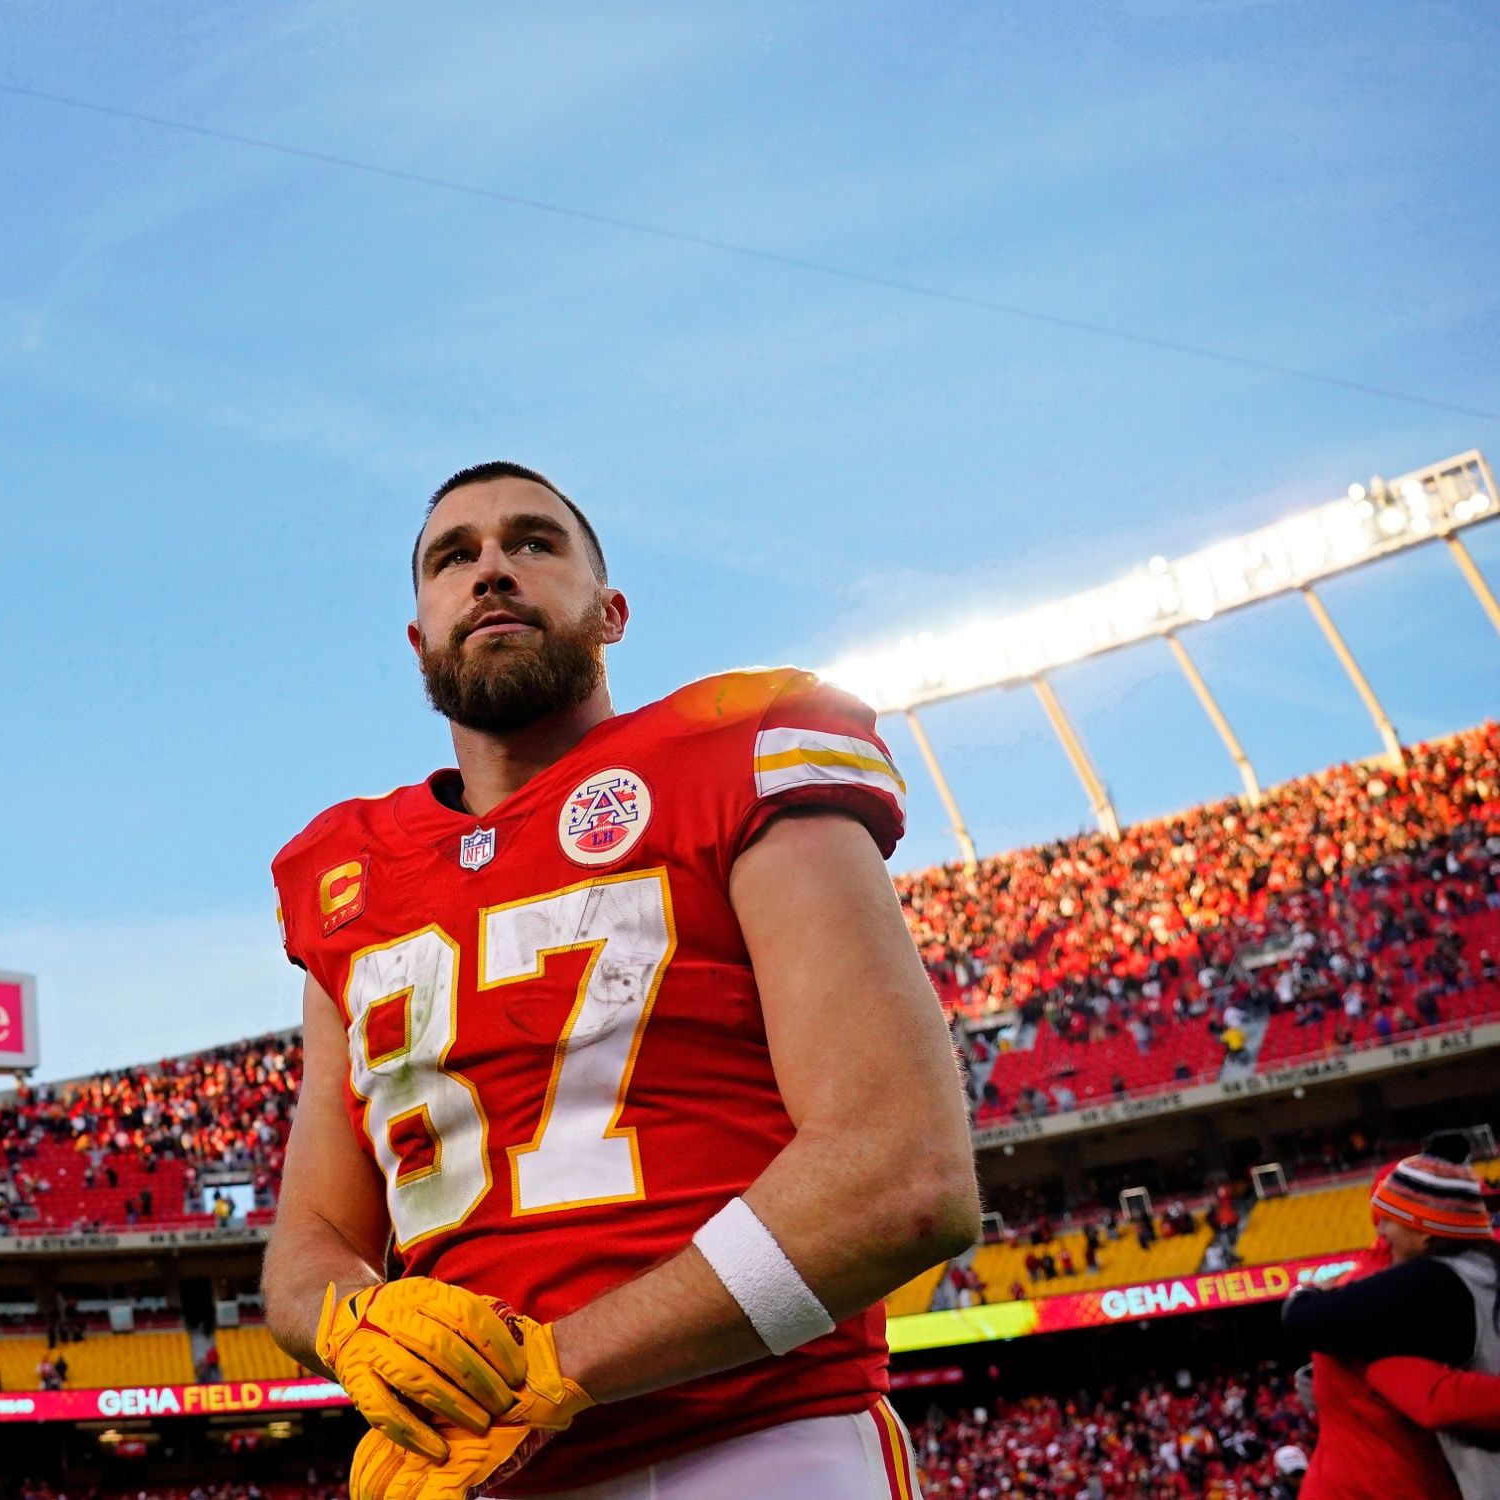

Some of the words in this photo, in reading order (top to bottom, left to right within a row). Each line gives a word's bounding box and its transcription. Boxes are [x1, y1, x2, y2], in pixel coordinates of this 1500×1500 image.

[465, 845, 488, 863] NFL
[320, 861, 362, 915] C
[343, 865, 678, 1253] 87
[1101, 1281, 1197, 1319] GEHA
[1196, 1266, 1290, 1306] FIELD
[98, 1388, 181, 1417] GEHA
[183, 1383, 263, 1413] FIELD
